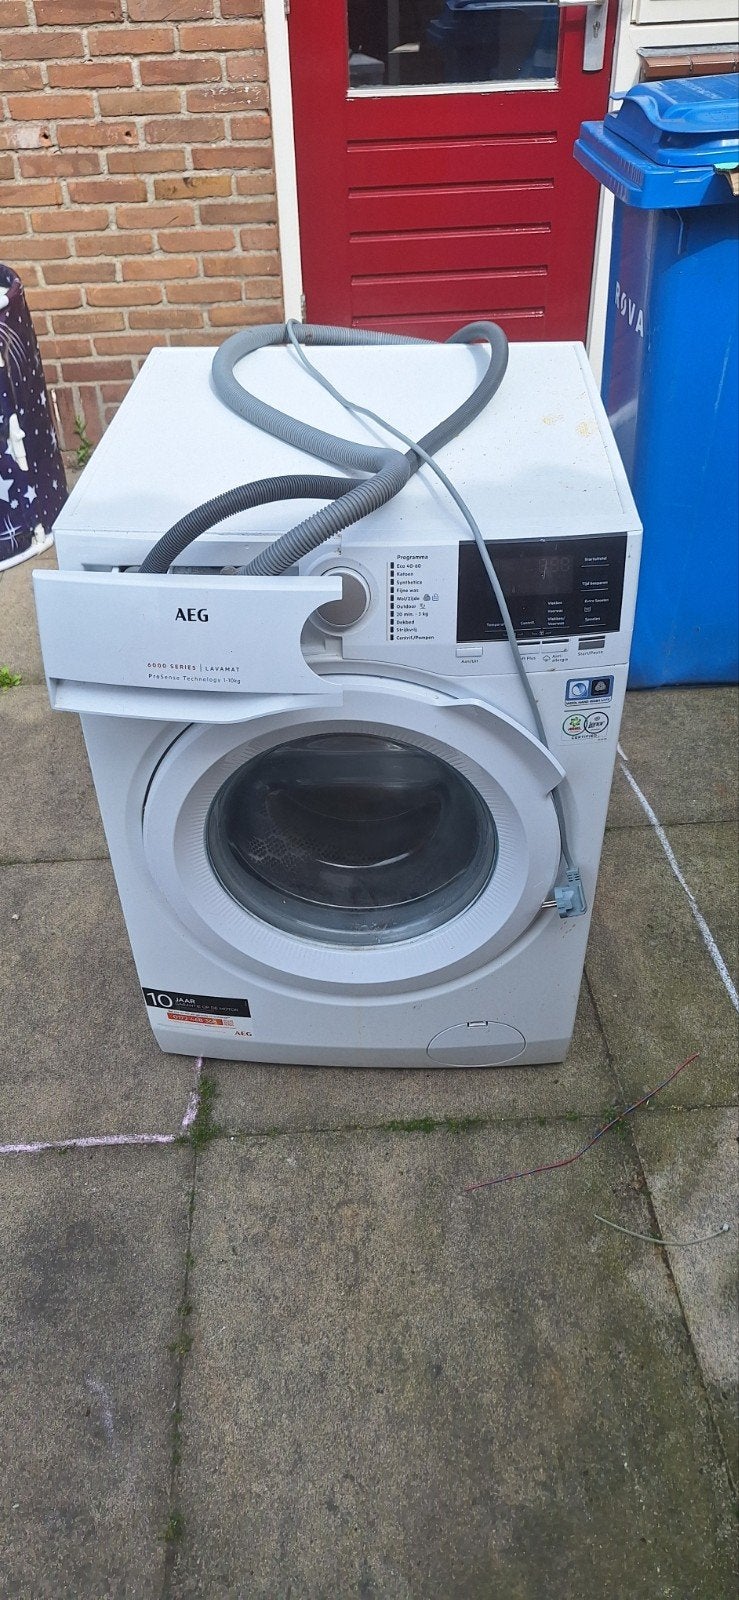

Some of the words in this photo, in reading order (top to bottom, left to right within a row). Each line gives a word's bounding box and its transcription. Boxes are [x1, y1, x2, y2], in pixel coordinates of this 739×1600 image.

[175, 607, 209, 622] AEG
[183, 675, 220, 683] Technology
[147, 992, 173, 1008] 10
